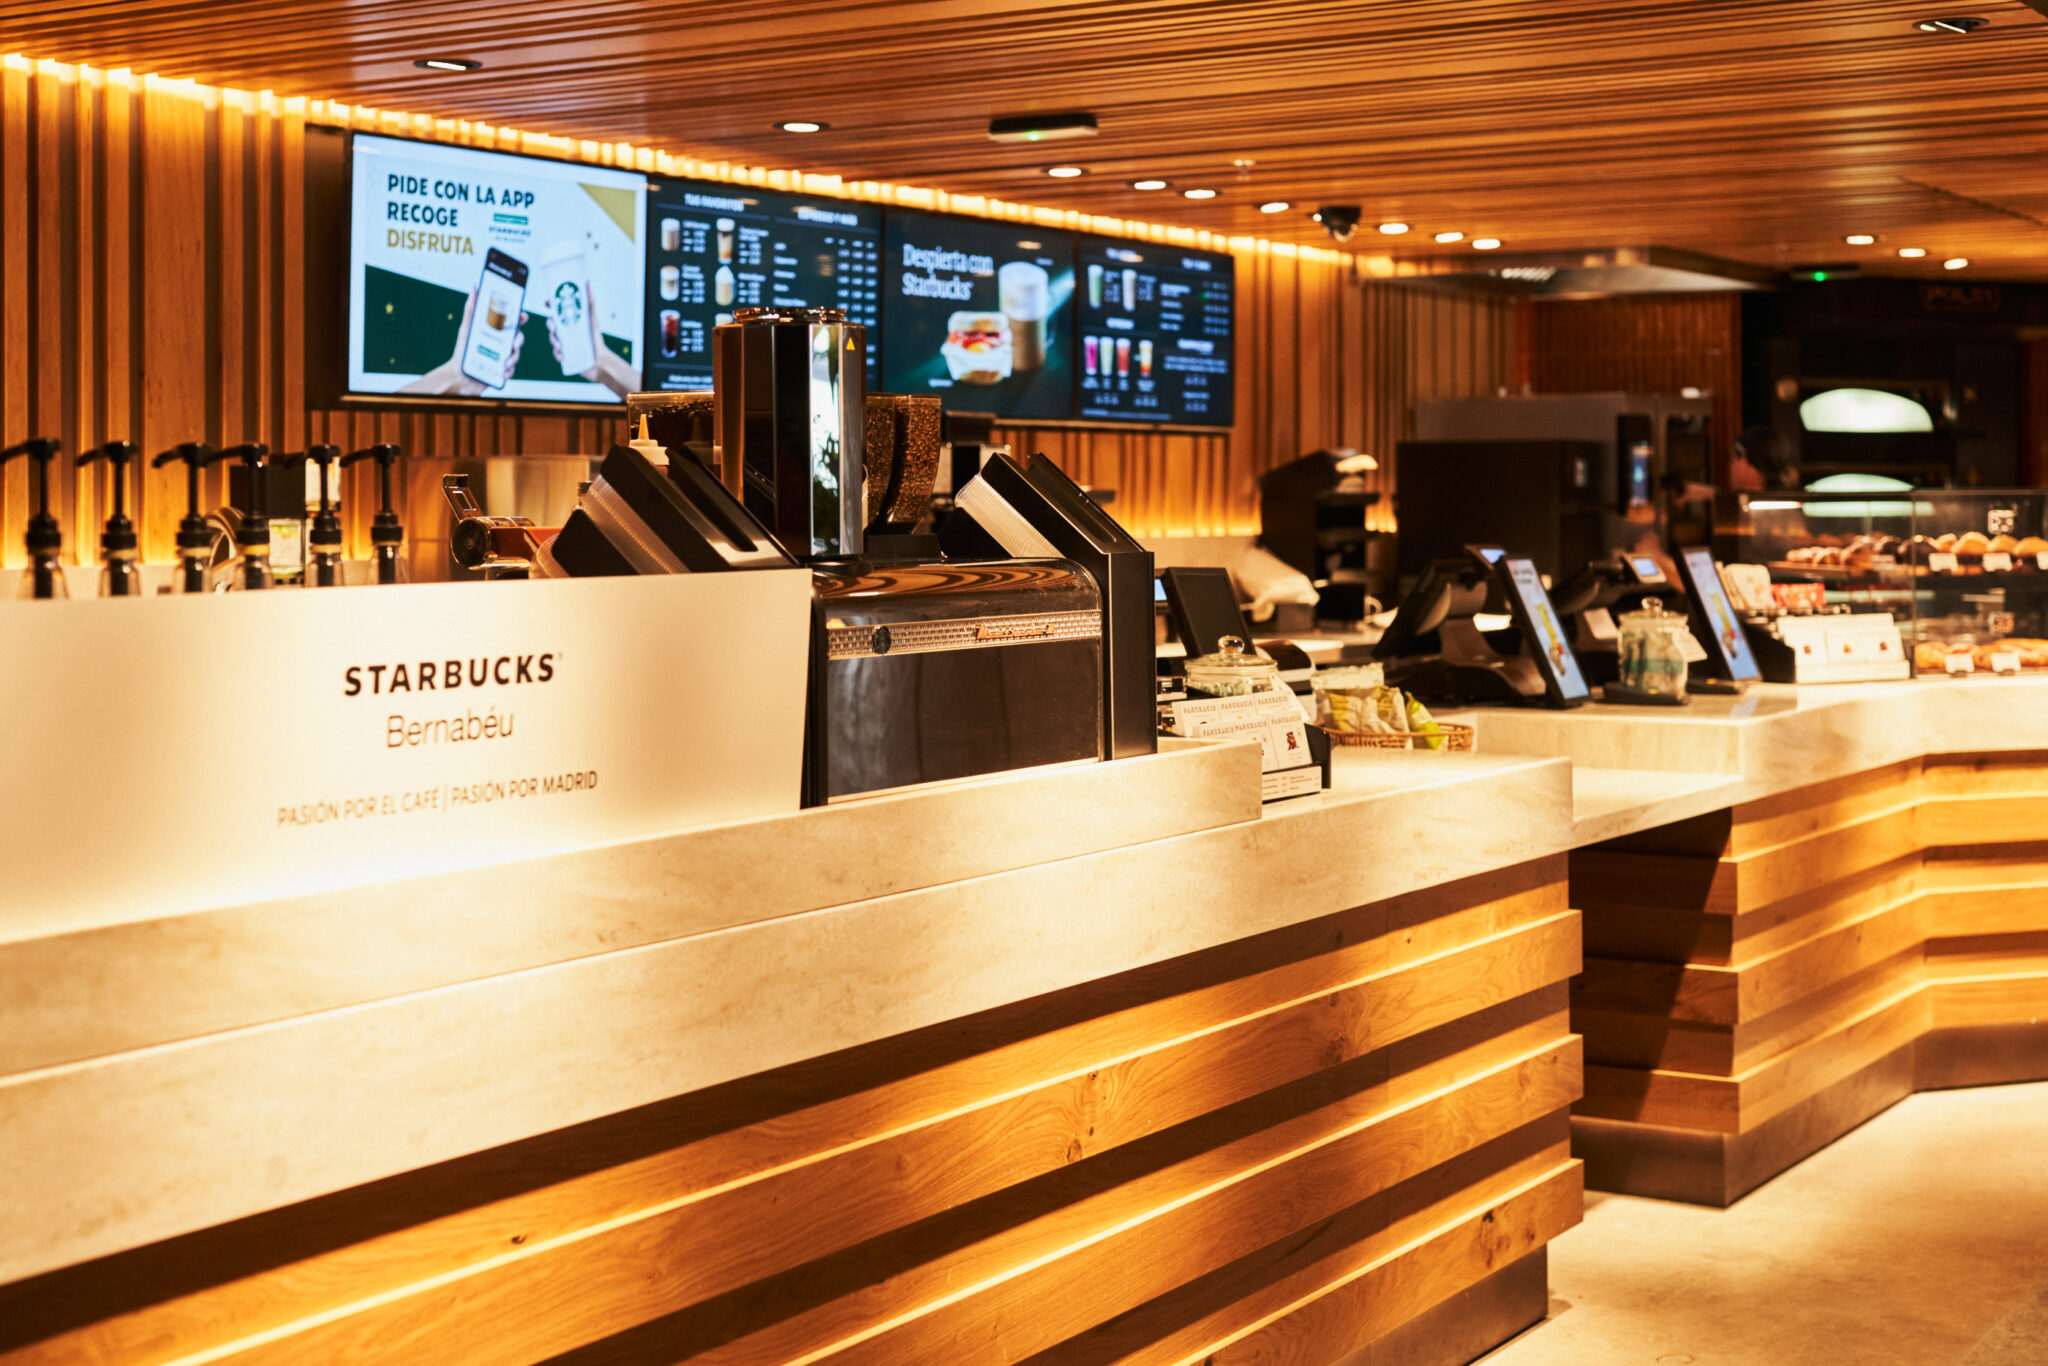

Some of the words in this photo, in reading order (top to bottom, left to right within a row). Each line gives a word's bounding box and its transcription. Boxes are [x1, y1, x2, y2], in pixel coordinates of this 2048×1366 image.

[388, 174, 428, 196] PIDE
[434, 180, 469, 201] CON
[476, 185, 495, 205] LA
[501, 189, 535, 209] APP
[387, 202, 458, 227] RECOGE
[387, 229, 474, 256] DISFRUTA
[903, 243, 968, 274] Despierta
[968, 254, 994, 274] con
[902, 272, 971, 301] Starbucks
[344, 653, 555, 697] STARBUCKS
[386, 705, 515, 749] Bernabéu
[277, 798, 340, 830] PASIÓN
[344, 796, 377, 819] POR
[382, 794, 396, 816] EL
[402, 785, 440, 813] CAFÉ
[451, 779, 505, 806] PASIÓN
[509, 777, 538, 799] POR
[542, 770, 599, 796] MADRID
